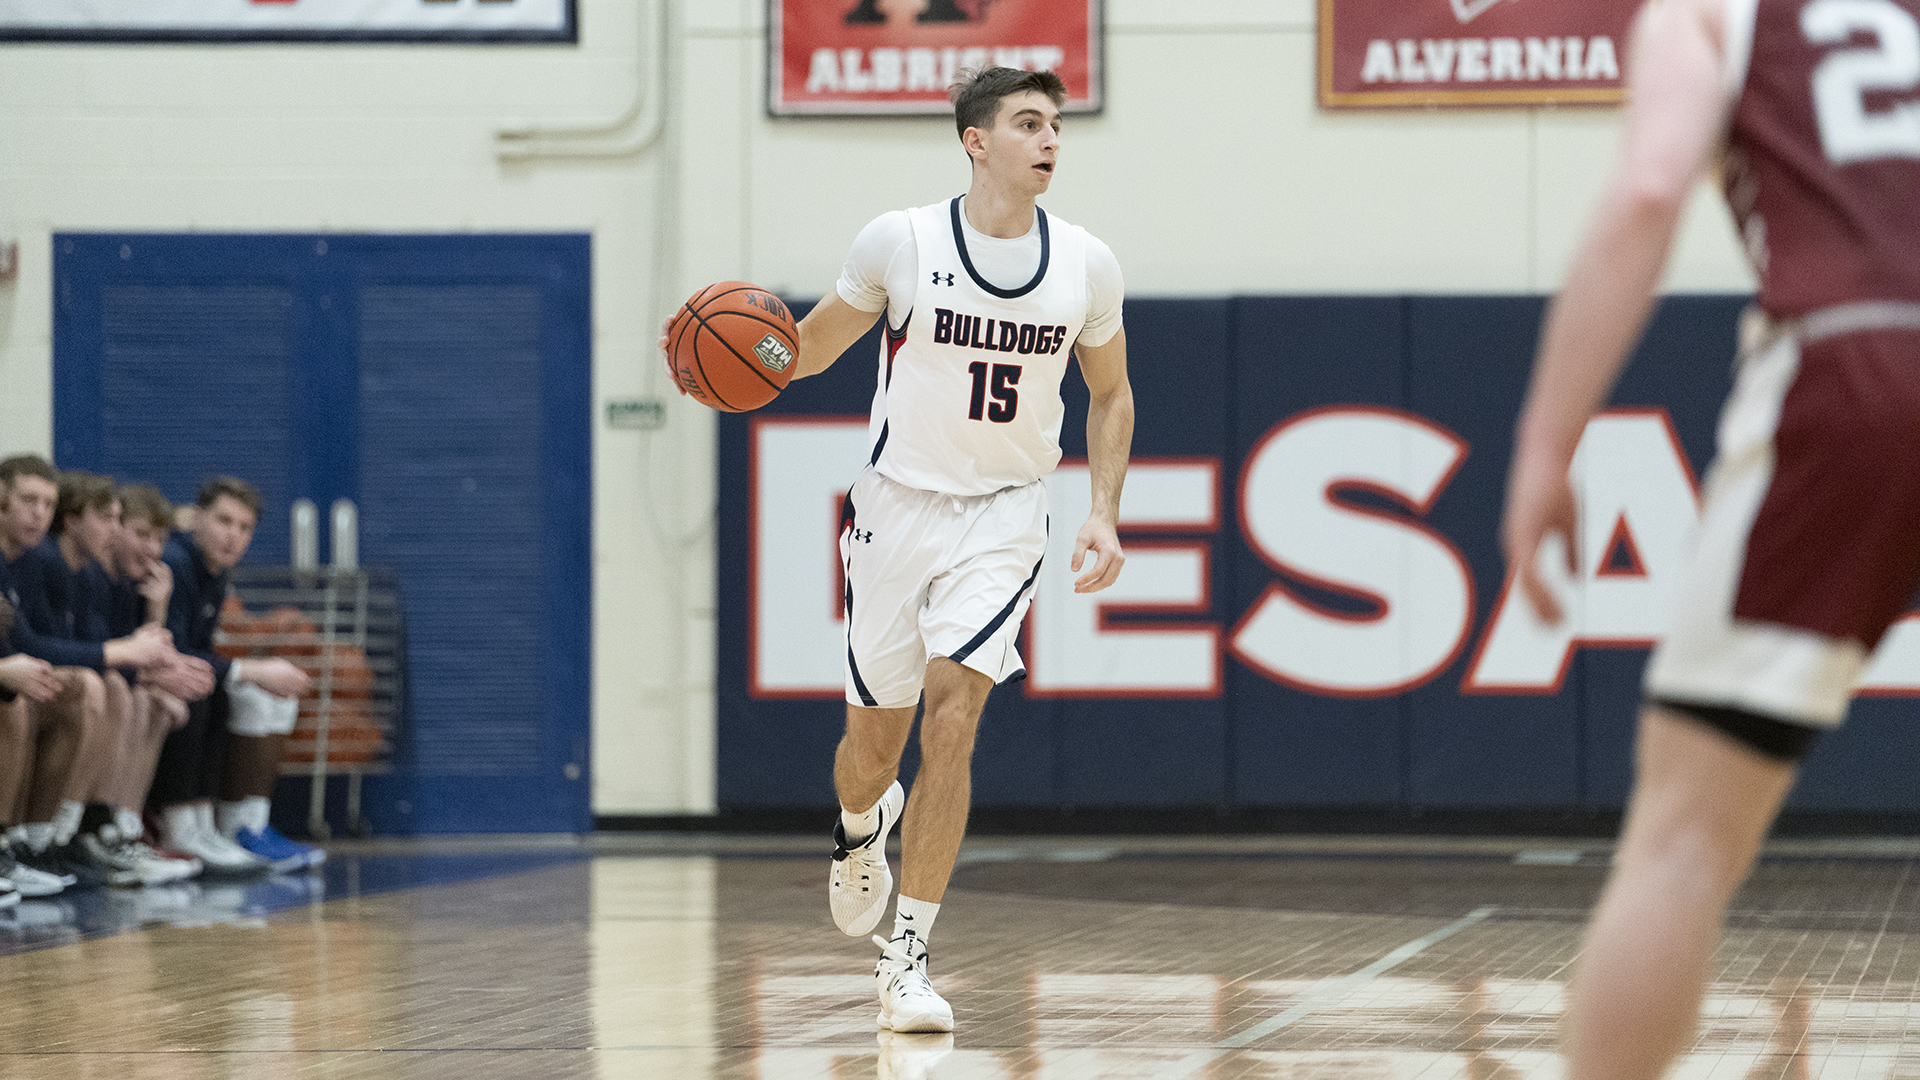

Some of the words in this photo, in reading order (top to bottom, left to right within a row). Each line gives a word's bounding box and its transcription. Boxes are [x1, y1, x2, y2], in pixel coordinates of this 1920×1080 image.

[1361, 36, 1619, 83] ALVERNIA
[761, 336, 793, 366] MAC
[933, 307, 1067, 356] BULLDOGS
[968, 360, 1023, 423] 15
